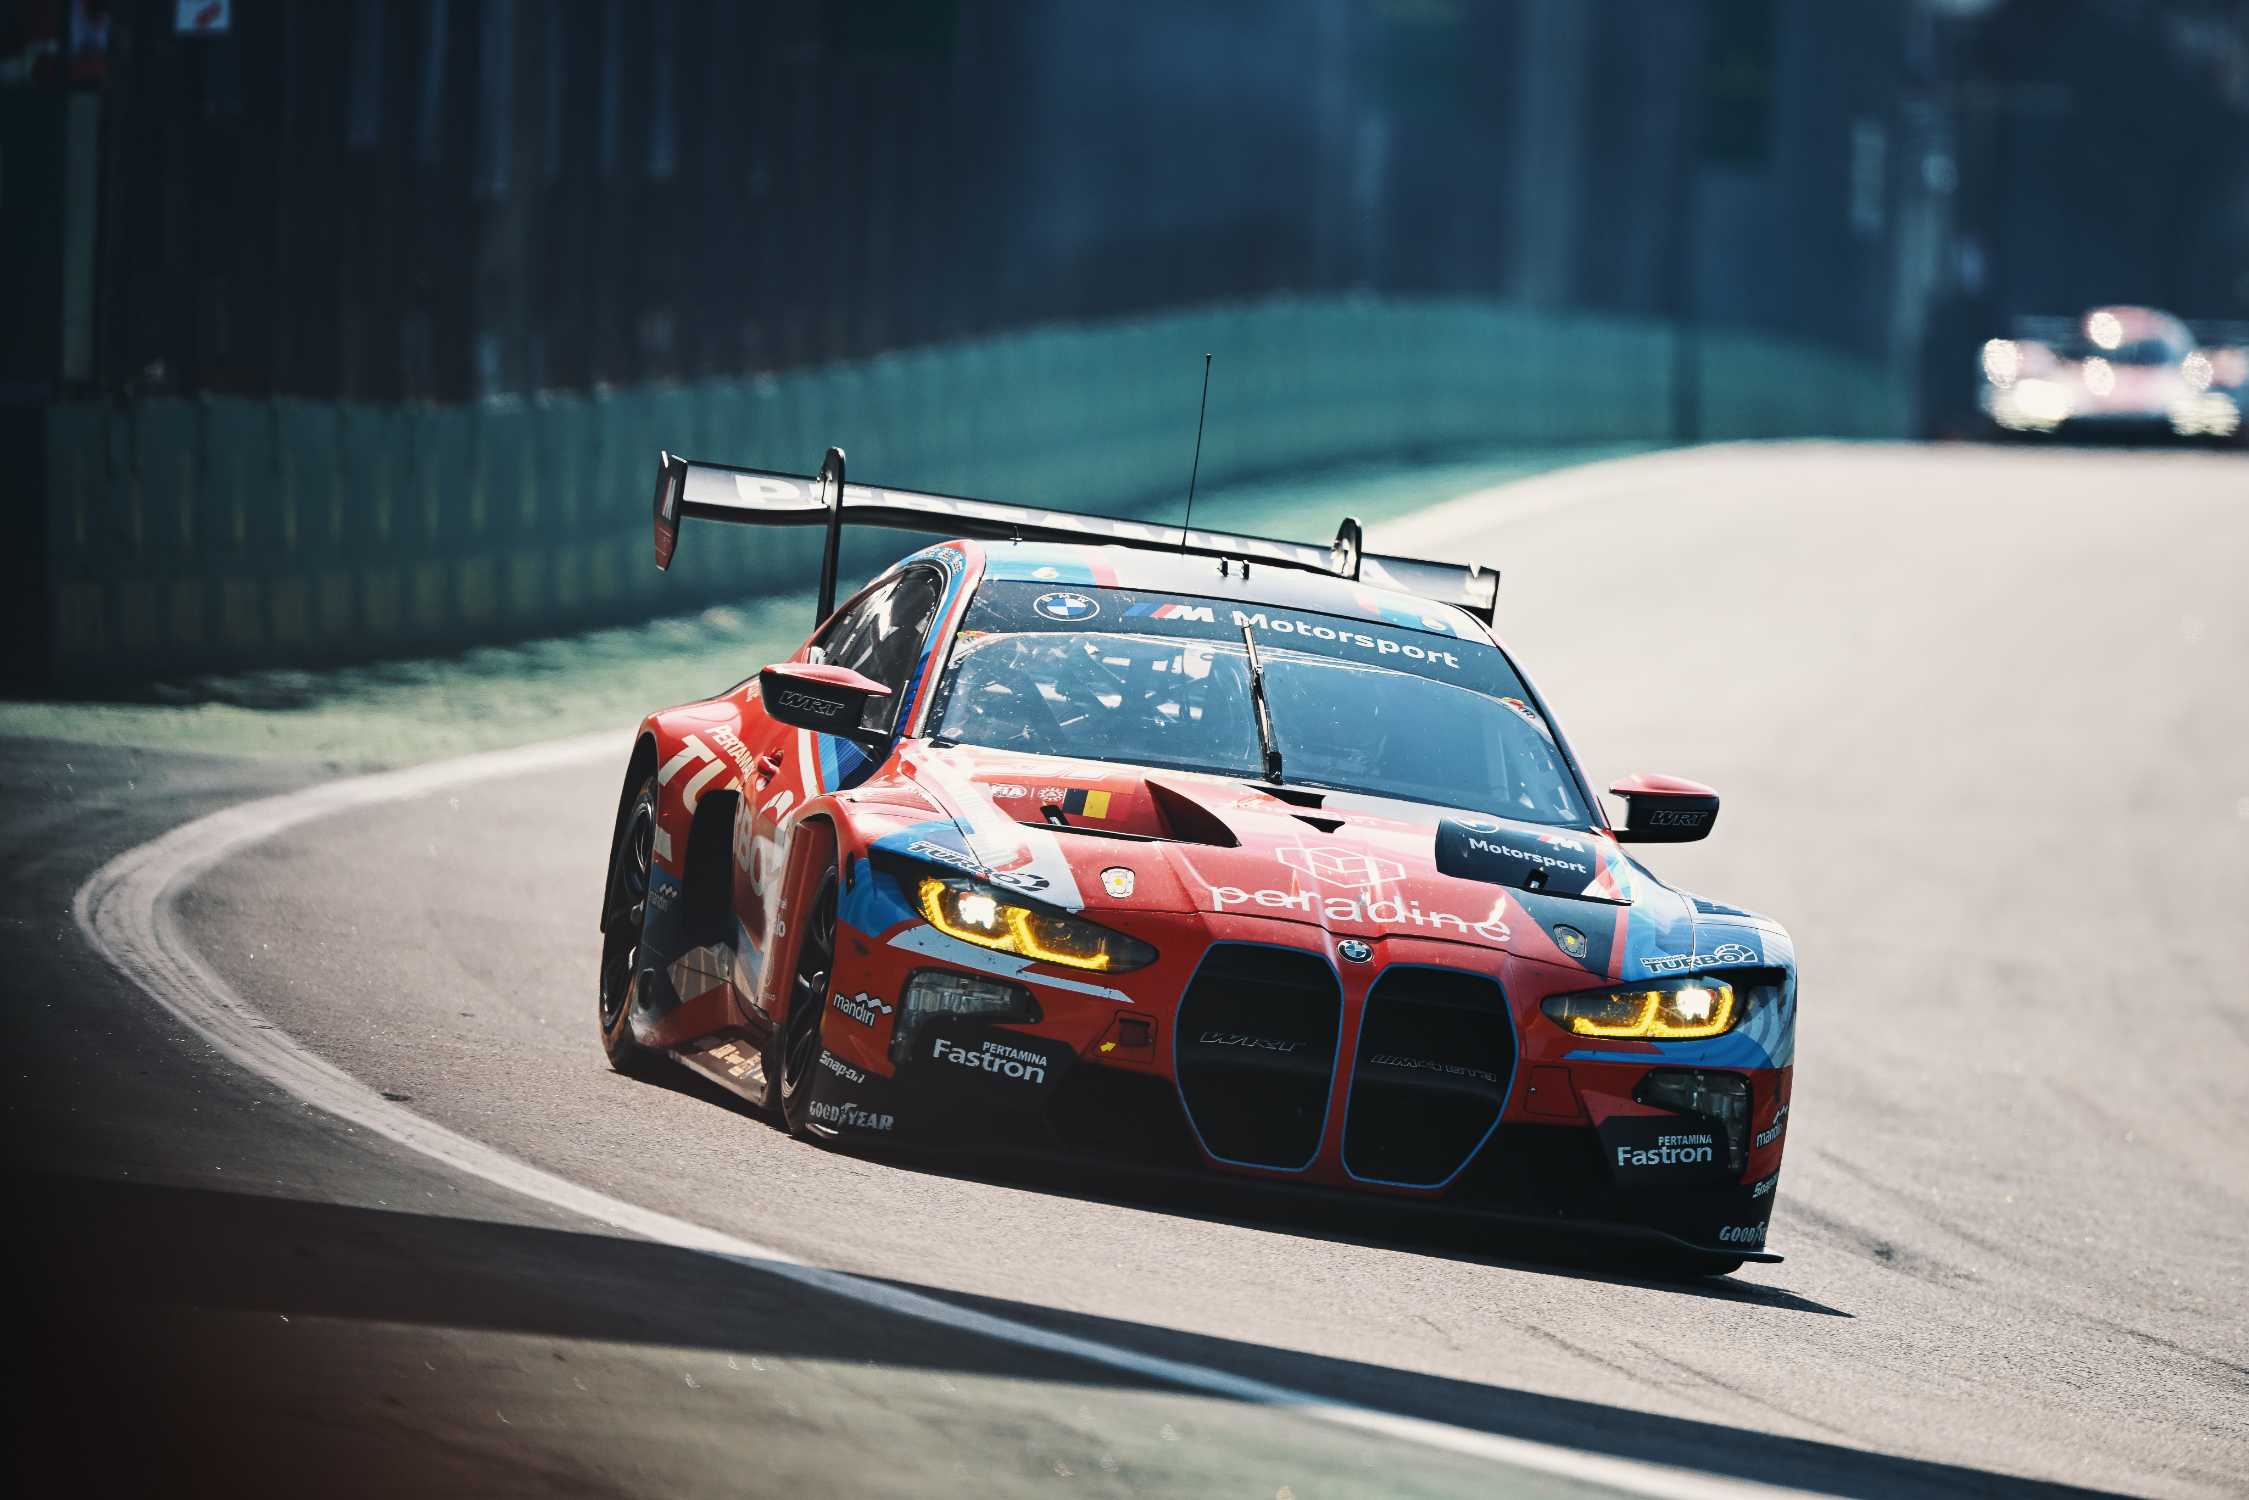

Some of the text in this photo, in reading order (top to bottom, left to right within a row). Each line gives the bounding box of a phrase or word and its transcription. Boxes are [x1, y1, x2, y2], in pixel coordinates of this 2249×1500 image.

[1232, 610, 1460, 669] Motorsport
[779, 690, 846, 716] WRT
[1468, 837, 1587, 874] Motorsport
[833, 992, 876, 1027] mandiri
[932, 1038, 1045, 1084] Fastron
[982, 1041, 1048, 1066] PERTAMINA
[809, 1100, 895, 1130] GOODYEAR
[1658, 1134, 1713, 1146] PERTAMINA
[1617, 1146, 1713, 1167] Fastron
